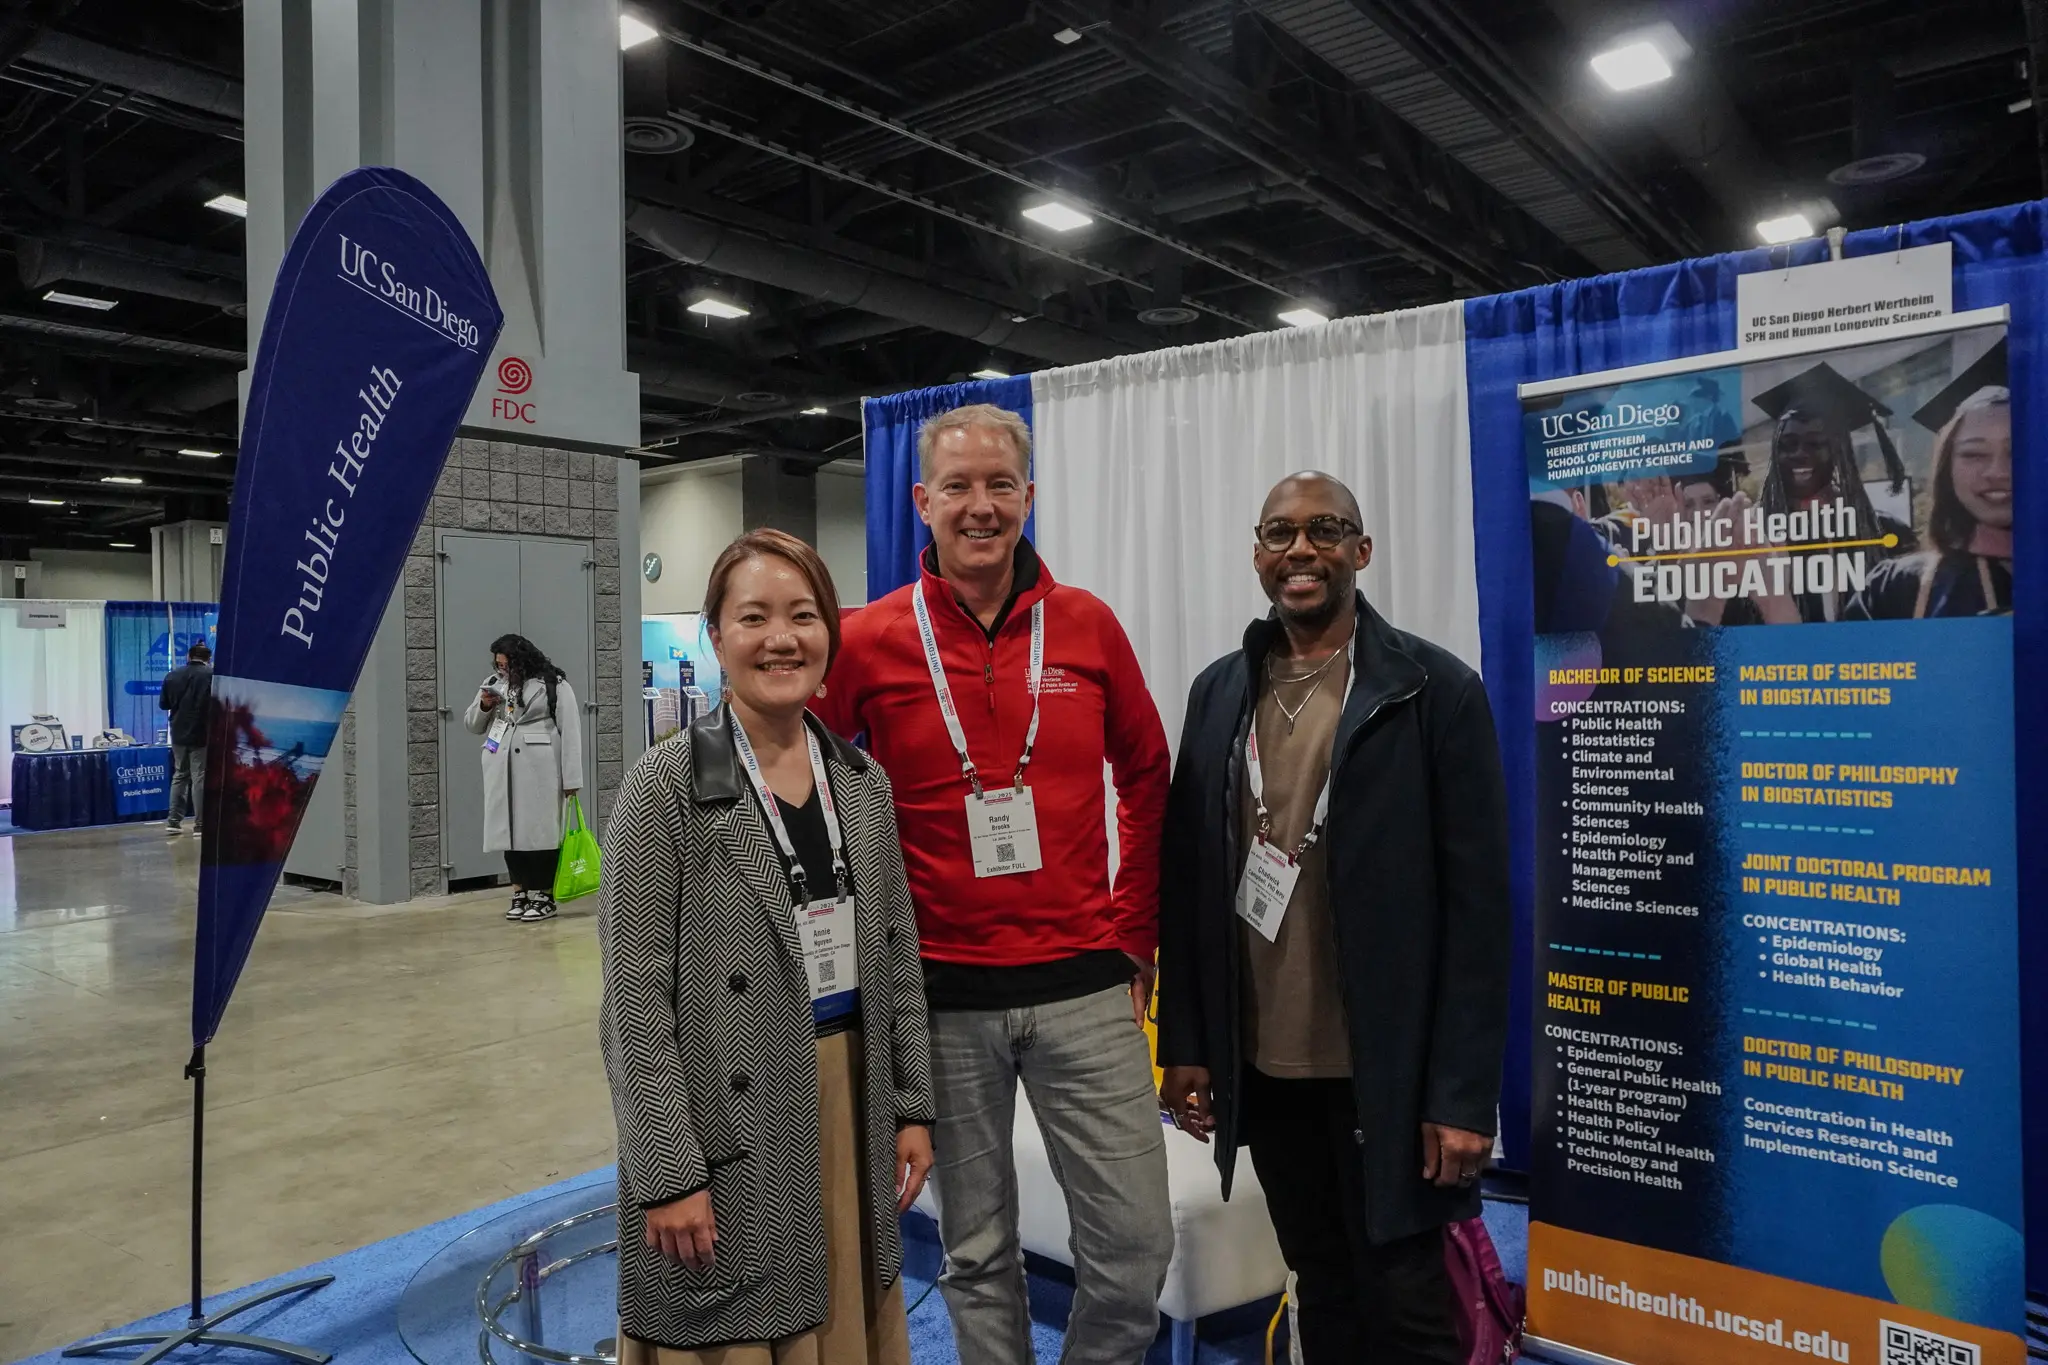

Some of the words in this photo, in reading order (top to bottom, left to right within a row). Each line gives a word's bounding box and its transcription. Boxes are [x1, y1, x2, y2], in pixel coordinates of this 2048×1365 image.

[339, 233, 377, 288] UC
[380, 263, 421, 315] San
[424, 286, 478, 347] Diego
[1752, 316, 1766, 327] UC
[1769, 314, 1789, 325] San
[1793, 310, 1825, 322] Diego
[1828, 302, 1871, 316] Herbert
[1874, 294, 1934, 311] Wertheim
[1746, 330, 1766, 343] SPH
[1769, 328, 1789, 340] and
[1792, 324, 1831, 337] Human
[1834, 316, 1890, 332] Longevity
[1892, 309, 1941, 324] Science
[492, 398, 536, 423] FDC
[1541, 413, 1573, 438] UC
[1576, 410, 1614, 433] San
[1618, 404, 1680, 427] Diego
[1546, 442, 1588, 458] HERBERT
[1589, 435, 1645, 450] WERTHEIM
[1547, 456, 1585, 469] SCHOOL
[1587, 452, 1601, 462] OF
[1602, 447, 1640, 461] PUBLIC
[1643, 441, 1686, 456] HEALTH
[1688, 438, 1714, 450] AND
[1548, 467, 1583, 480] HUMAN
[1585, 458, 1643, 475] LONGEVITY
[1645, 454, 1693, 468] SCIENCE
[281, 498, 345, 650] Public
[328, 365, 402, 497] Health
[1632, 510, 1733, 553] Public
[1743, 497, 1856, 545] Health
[1633, 552, 1866, 603] EDUCATION
[922, 621, 933, 646] HEALTH
[928, 646, 940, 673] UNITED
[1033, 640, 1041, 666] UNITED
[1549, 668, 1620, 685] BACHELOR
[1624, 667, 1644, 683] OF
[1647, 666, 1715, 683] SCIENCE
[1740, 665, 1808, 681] MASTER
[1812, 664, 1835, 680] OF
[1839, 662, 1917, 680] SCIENCE
[1550, 700, 1685, 714] CONCENTRATIONS:
[1740, 689, 1758, 705] IN
[1762, 688, 1892, 705] BIOSTATISTICS
[1572, 717, 1612, 730] Public
[1615, 718, 1662, 730] Health
[812, 741, 821, 765] UNITED
[1572, 733, 1655, 747] Biostatistics
[740, 742, 757, 771] UNITED
[1572, 750, 1623, 763] Climate
[1625, 751, 1652, 763] and
[117, 764, 164, 779] Creighton
[1572, 766, 1675, 781] Environmental
[1741, 762, 1808, 780] DOCTOR
[1813, 764, 1835, 781] OF
[1839, 765, 1959, 785] PHILOSOPHY
[1572, 782, 1629, 795] Sciences
[1741, 786, 1759, 802] IN
[1764, 786, 1893, 808] BIOSTATISTICS
[989, 814, 1009, 823] Randy
[1572, 799, 1651, 816] Community
[1654, 801, 1704, 816] Health
[992, 823, 1010, 831] Brooks
[1572, 814, 1630, 829] Sciences
[1572, 831, 1666, 850] Epidemiology
[987, 865, 1010, 873] Exhibitor
[1572, 847, 1616, 861] Health
[1619, 850, 1663, 866] Policy
[1666, 853, 1694, 866] and
[1258, 866, 1280, 886] Chadwick
[1572, 863, 1662, 881] Management
[1742, 854, 1791, 872] JOINT
[1796, 856, 1888, 880] DOCTORAL
[1892, 864, 1991, 887] PROGRAM
[1572, 879, 1630, 895] Sciences
[1742, 877, 1760, 893] IN
[1765, 879, 1827, 899] PUBLIC
[1831, 884, 1900, 906] HEALTH
[1572, 895, 1633, 912] Medicine
[1636, 901, 1699, 917] Sciences
[813, 928, 831, 938] Annie
[1742, 914, 1906, 944] CONCENTRATIONS:
[813, 938, 832, 947] Nguyen
[1772, 935, 1883, 961] Epidemiology
[1772, 952, 1824, 971] Global
[1827, 958, 1882, 977] Health
[817, 984, 837, 994] Member
[1548, 971, 1604, 993] MASTER
[1608, 980, 1628, 996] OF
[1631, 982, 1689, 1003] PUBLIC
[1772, 970, 1826, 988] Health
[1829, 976, 1904, 998] Behavior
[1547, 993, 1600, 1016] HEALTH
[1544, 1024, 1683, 1056] CONCENTRATIONS:
[1567, 1045, 1663, 1072] Epidemiology
[1743, 1036, 1811, 1061] DOCTOR
[1816, 1046, 1840, 1065] OF
[1844, 1050, 1964, 1086] PHILOSOPHY
[1567, 1062, 1620, 1081] General
[1623, 1070, 1669, 1088] Public
[1672, 1077, 1722, 1096] Health
[1743, 1060, 1761, 1077] IN
[1766, 1063, 1829, 1088] PUBLIC
[1833, 1073, 1904, 1101] HEALTH
[1567, 1077, 1616, 1096] (1-year
[1619, 1088, 1688, 1109] program)
[1567, 1094, 1613, 1113] Health
[1616, 1102, 1681, 1123] Behavior
[1567, 1111, 1613, 1129] Health
[1616, 1118, 1660, 1139] Policy
[1744, 1097, 1866, 1129] Concentration
[1870, 1117, 1887, 1134] in
[1891, 1122, 1953, 1147] Health
[1568, 1127, 1610, 1145] Public
[1613, 1134, 1662, 1154] Mental
[1665, 1143, 1715, 1163] Health
[1744, 1116, 1814, 1140] Services
[1817, 1128, 1899, 1155] Research
[1903, 1150, 1938, 1164] and
[1567, 1142, 1648, 1170] Technology
[1651, 1161, 1678, 1173] and
[1744, 1134, 1884, 1172] Implementation
[1887, 1160, 1958, 1188] Science
[1567, 1158, 1631, 1181] Precision
[1634, 1171, 1683, 1190] Health
[1543, 1267, 1849, 1364] publichealth.ucsd.edu
